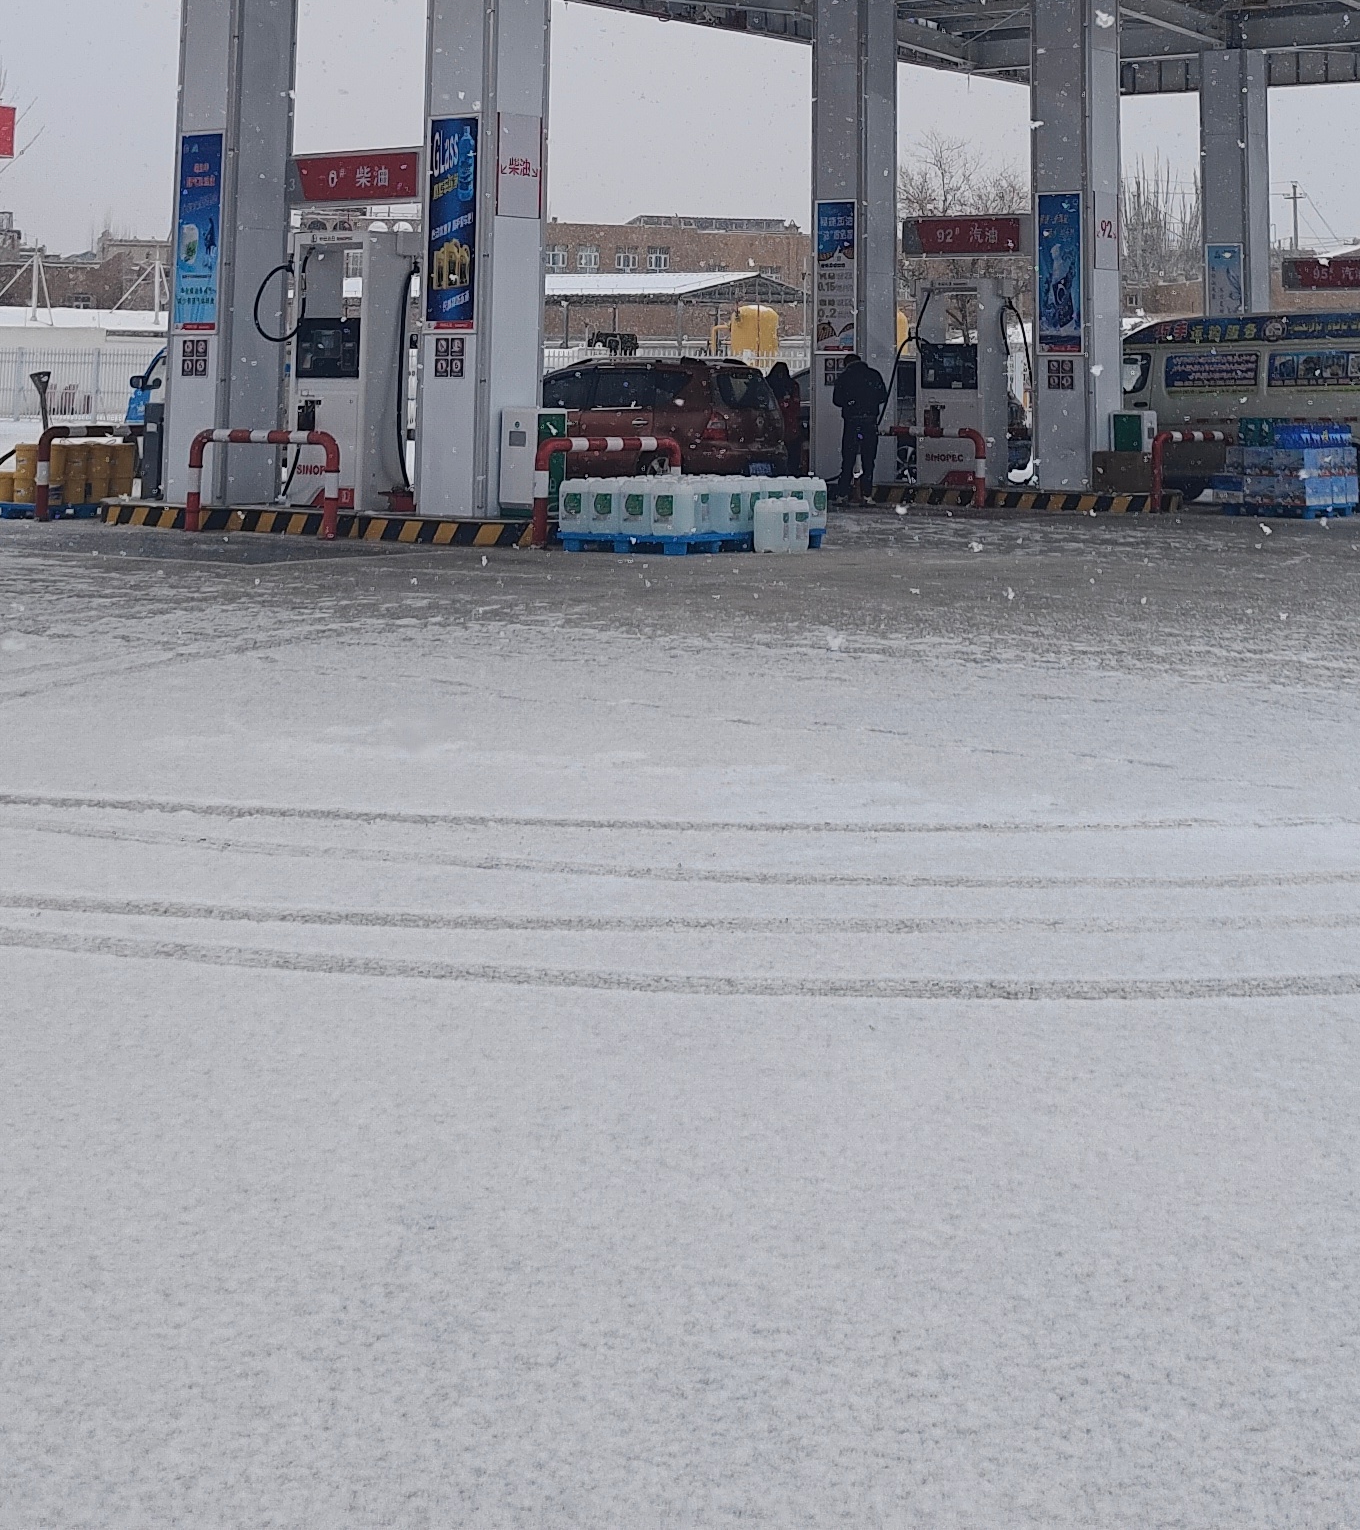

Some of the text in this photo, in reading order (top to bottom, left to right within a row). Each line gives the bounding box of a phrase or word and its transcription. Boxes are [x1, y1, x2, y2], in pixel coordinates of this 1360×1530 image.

[355, 166, 389, 188] 柴油
[508, 156, 531, 177] 柴油
[968, 223, 999, 245] 汽油
[1100, 219, 1114, 239] 92
[296, 464, 326, 476] SINOP
